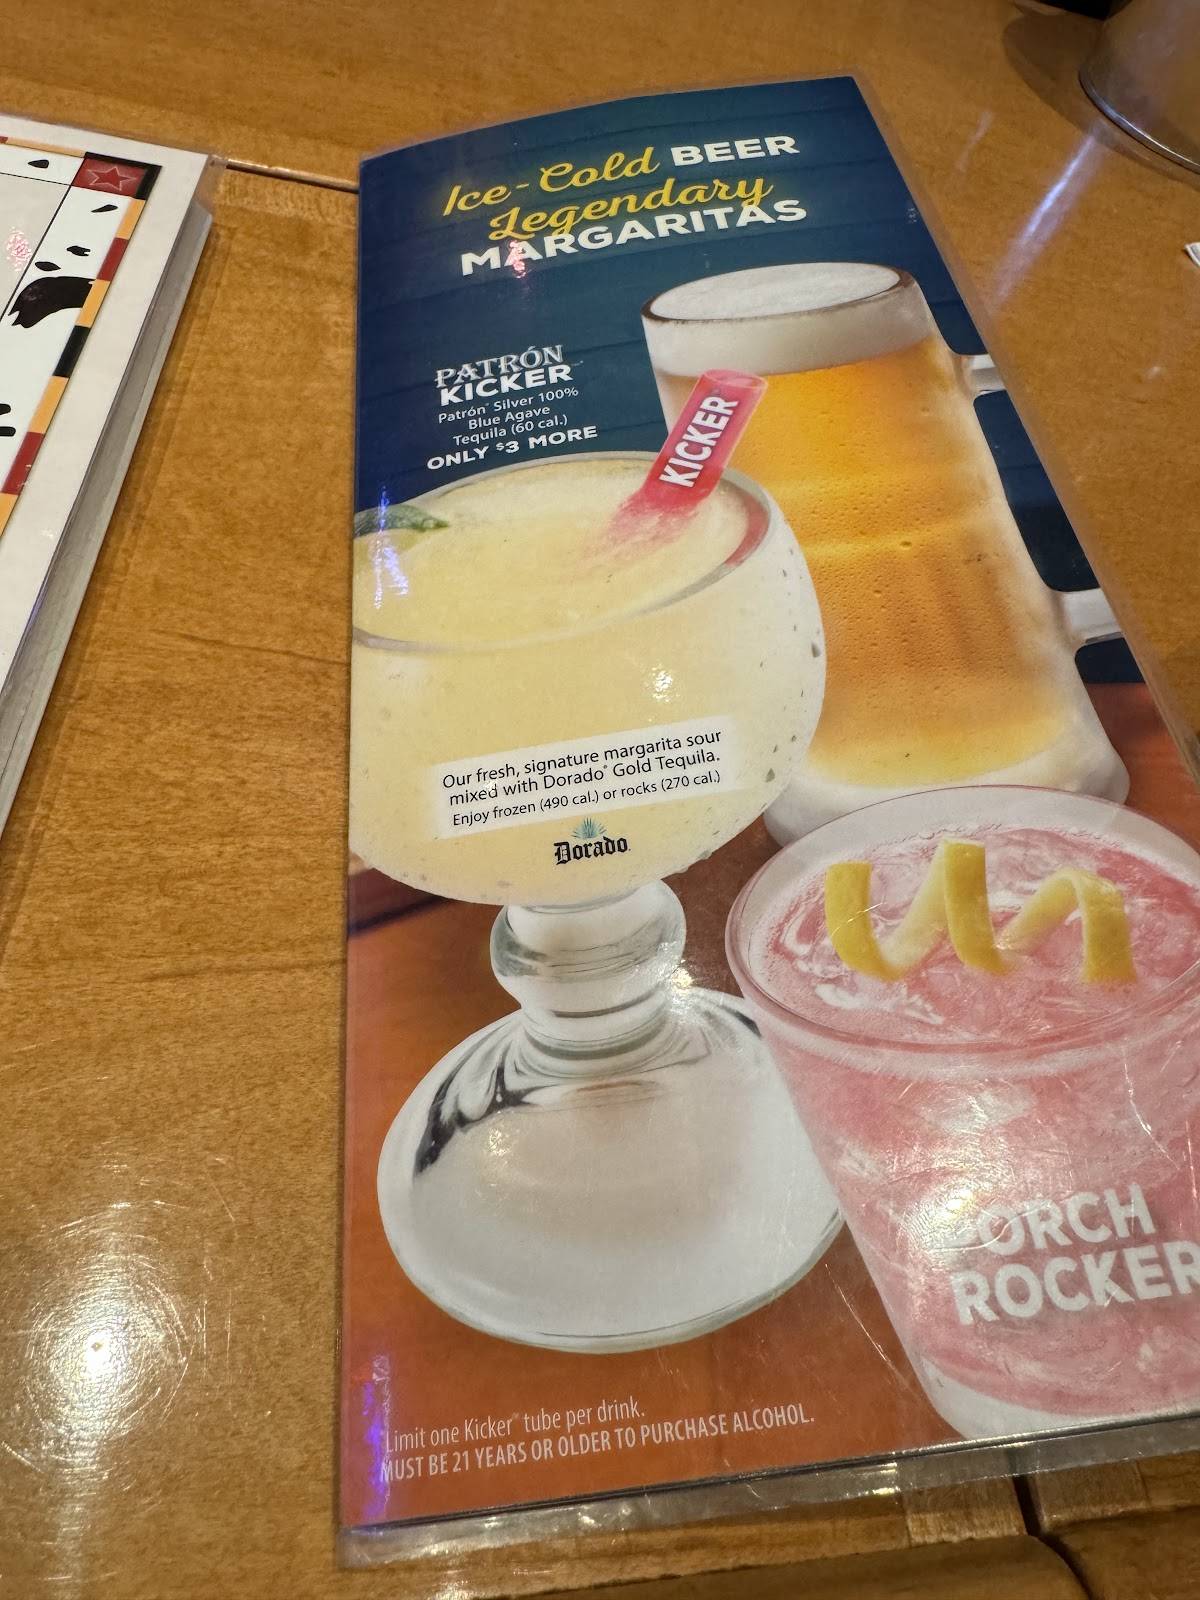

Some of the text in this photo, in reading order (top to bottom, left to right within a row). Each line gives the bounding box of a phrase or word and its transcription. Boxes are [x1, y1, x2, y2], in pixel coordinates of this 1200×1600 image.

[671, 136, 800, 166] BEER
[488, 177, 774, 241] Legendary
[461, 200, 807, 276] MARGARITAS
[435, 345, 564, 388] PATRÓN
[440, 364, 573, 406] KICKER
[469, 406, 550, 430] Blue Agave
[494, 396, 533, 412] Silver
[539, 387, 579, 402] 100%
[427, 426, 598, 470] ONLY $3 MORE
[453, 414, 568, 446] Tequila (60 cal.)
[659, 397, 739, 487] KICKER
[443, 731, 721, 788] Our fresh, signature margarita sour
[449, 787, 498, 806] mixed
[504, 779, 538, 797] with
[613, 759, 652, 778] Gold
[658, 749, 721, 771] Tequila.
[453, 770, 721, 826] Enjoy frozen (490 cal.) or rocks (270 cal.)
[554, 835, 628, 865] Dorado
[950, 1240, 1200, 1325] ROCKER
[381, 1403, 814, 1482] MUST BE 21 YEARS OR OLDER TO PURCHASE ALCOHOL.
[385, 1425, 425, 1453] Limit
[430, 1429, 459, 1447] one
[524, 1408, 561, 1432] tube
[567, 1407, 592, 1435] per
[598, 1396, 645, 1422] drink.
